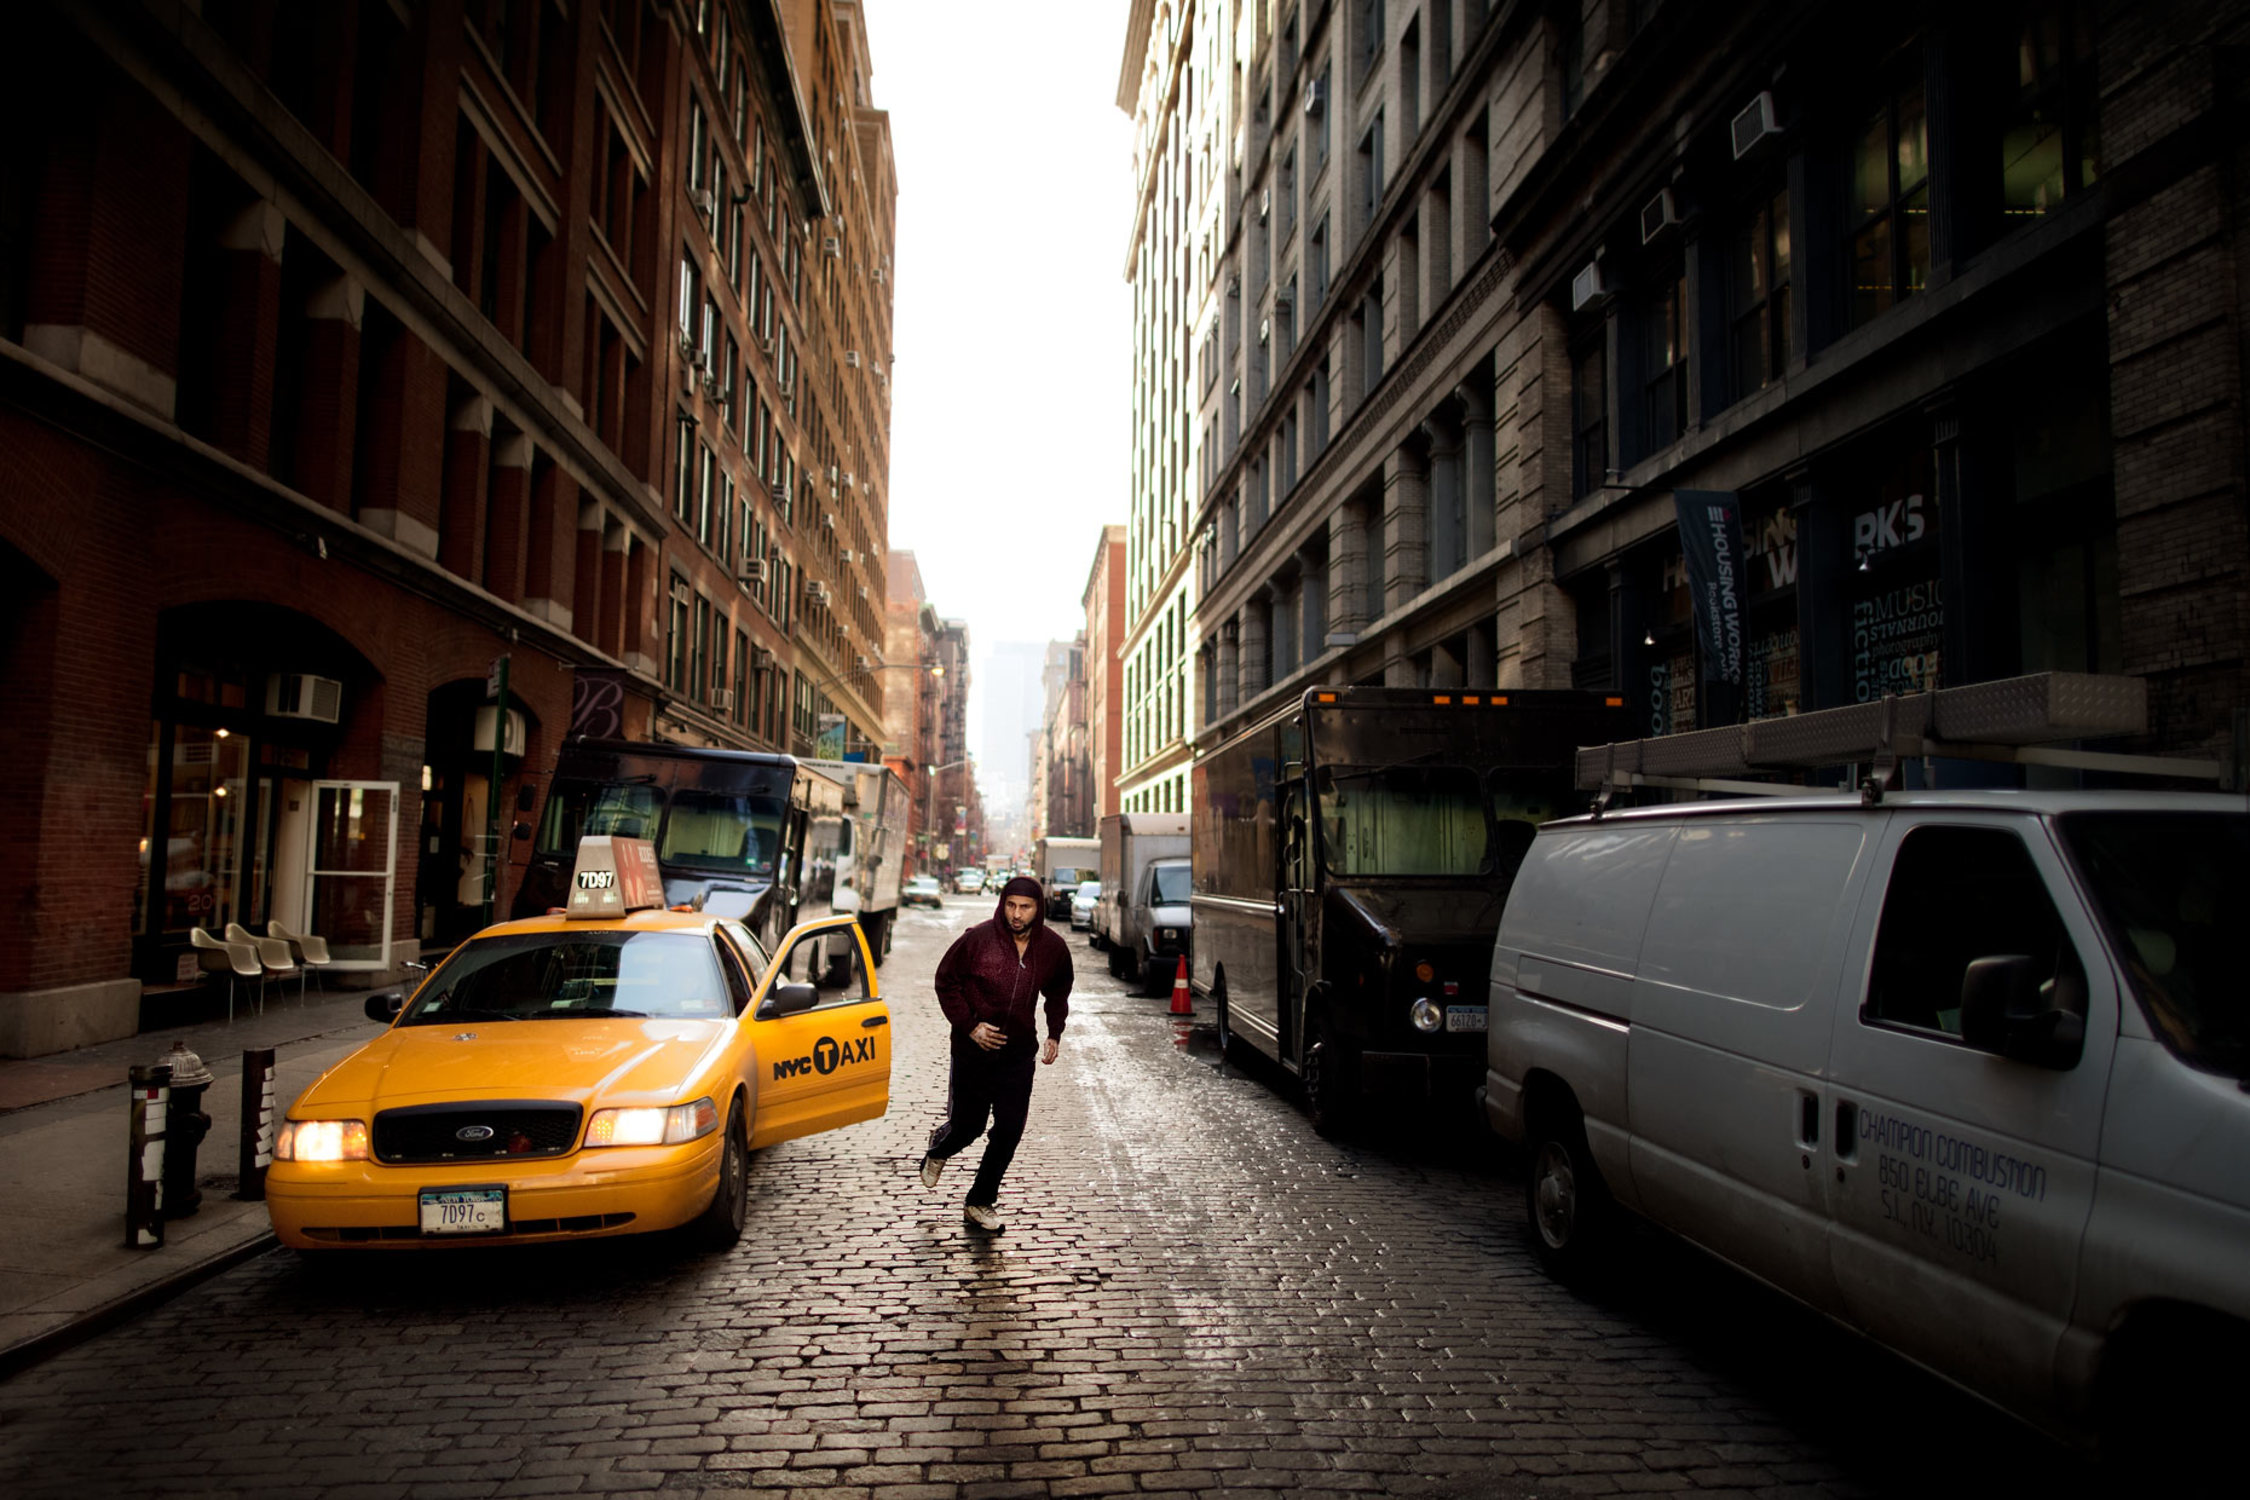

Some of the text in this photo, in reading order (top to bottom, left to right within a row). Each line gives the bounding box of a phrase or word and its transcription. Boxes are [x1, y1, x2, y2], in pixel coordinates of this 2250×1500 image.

[1709, 523, 1737, 609] HOUSING
[581, 872, 613, 889] 7D97
[773, 1036, 876, 1081] NYC TAXI
[1859, 1109, 2047, 1202] CHAMPION COMBUSTION
[1879, 1154, 2001, 1230] 850 ELBE AVE
[1945, 1214, 1998, 1269] 10304
